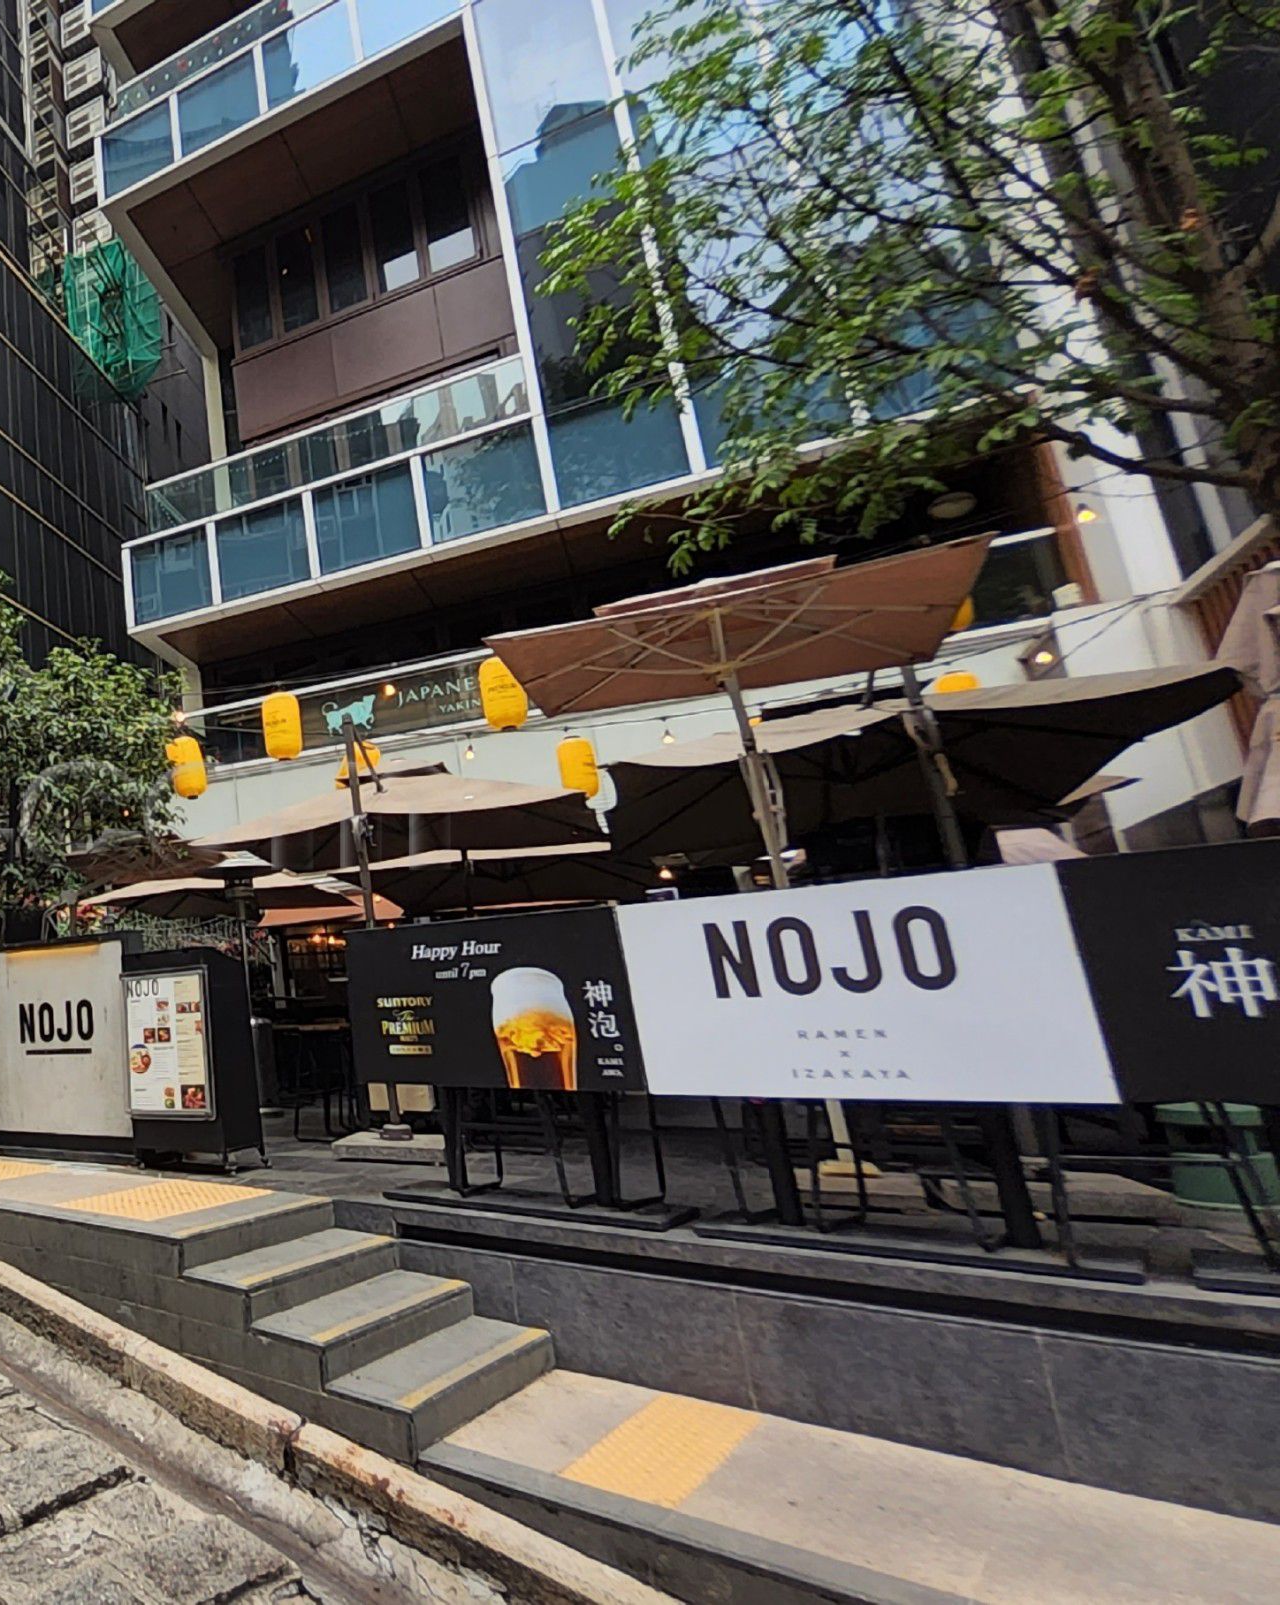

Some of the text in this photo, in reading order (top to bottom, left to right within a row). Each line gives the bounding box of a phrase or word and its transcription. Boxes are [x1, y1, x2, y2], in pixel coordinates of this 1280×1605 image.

[398, 677, 478, 707] JAPANE
[439, 698, 481, 714] YAKIN
[411, 940, 501, 961] Happy Hour
[702, 905, 956, 999] NOJO
[435, 967, 458, 979] until
[127, 978, 160, 999] NOJO
[1165, 947, 1278, 1018] 神
[376, 996, 433, 1008] SUNTORY
[19, 998, 94, 1044] NOJO
[381, 1019, 435, 1035] PREMIUM
[797, 1028, 887, 1040] RAMEN
[792, 1068, 911, 1080] IZAKAYA
